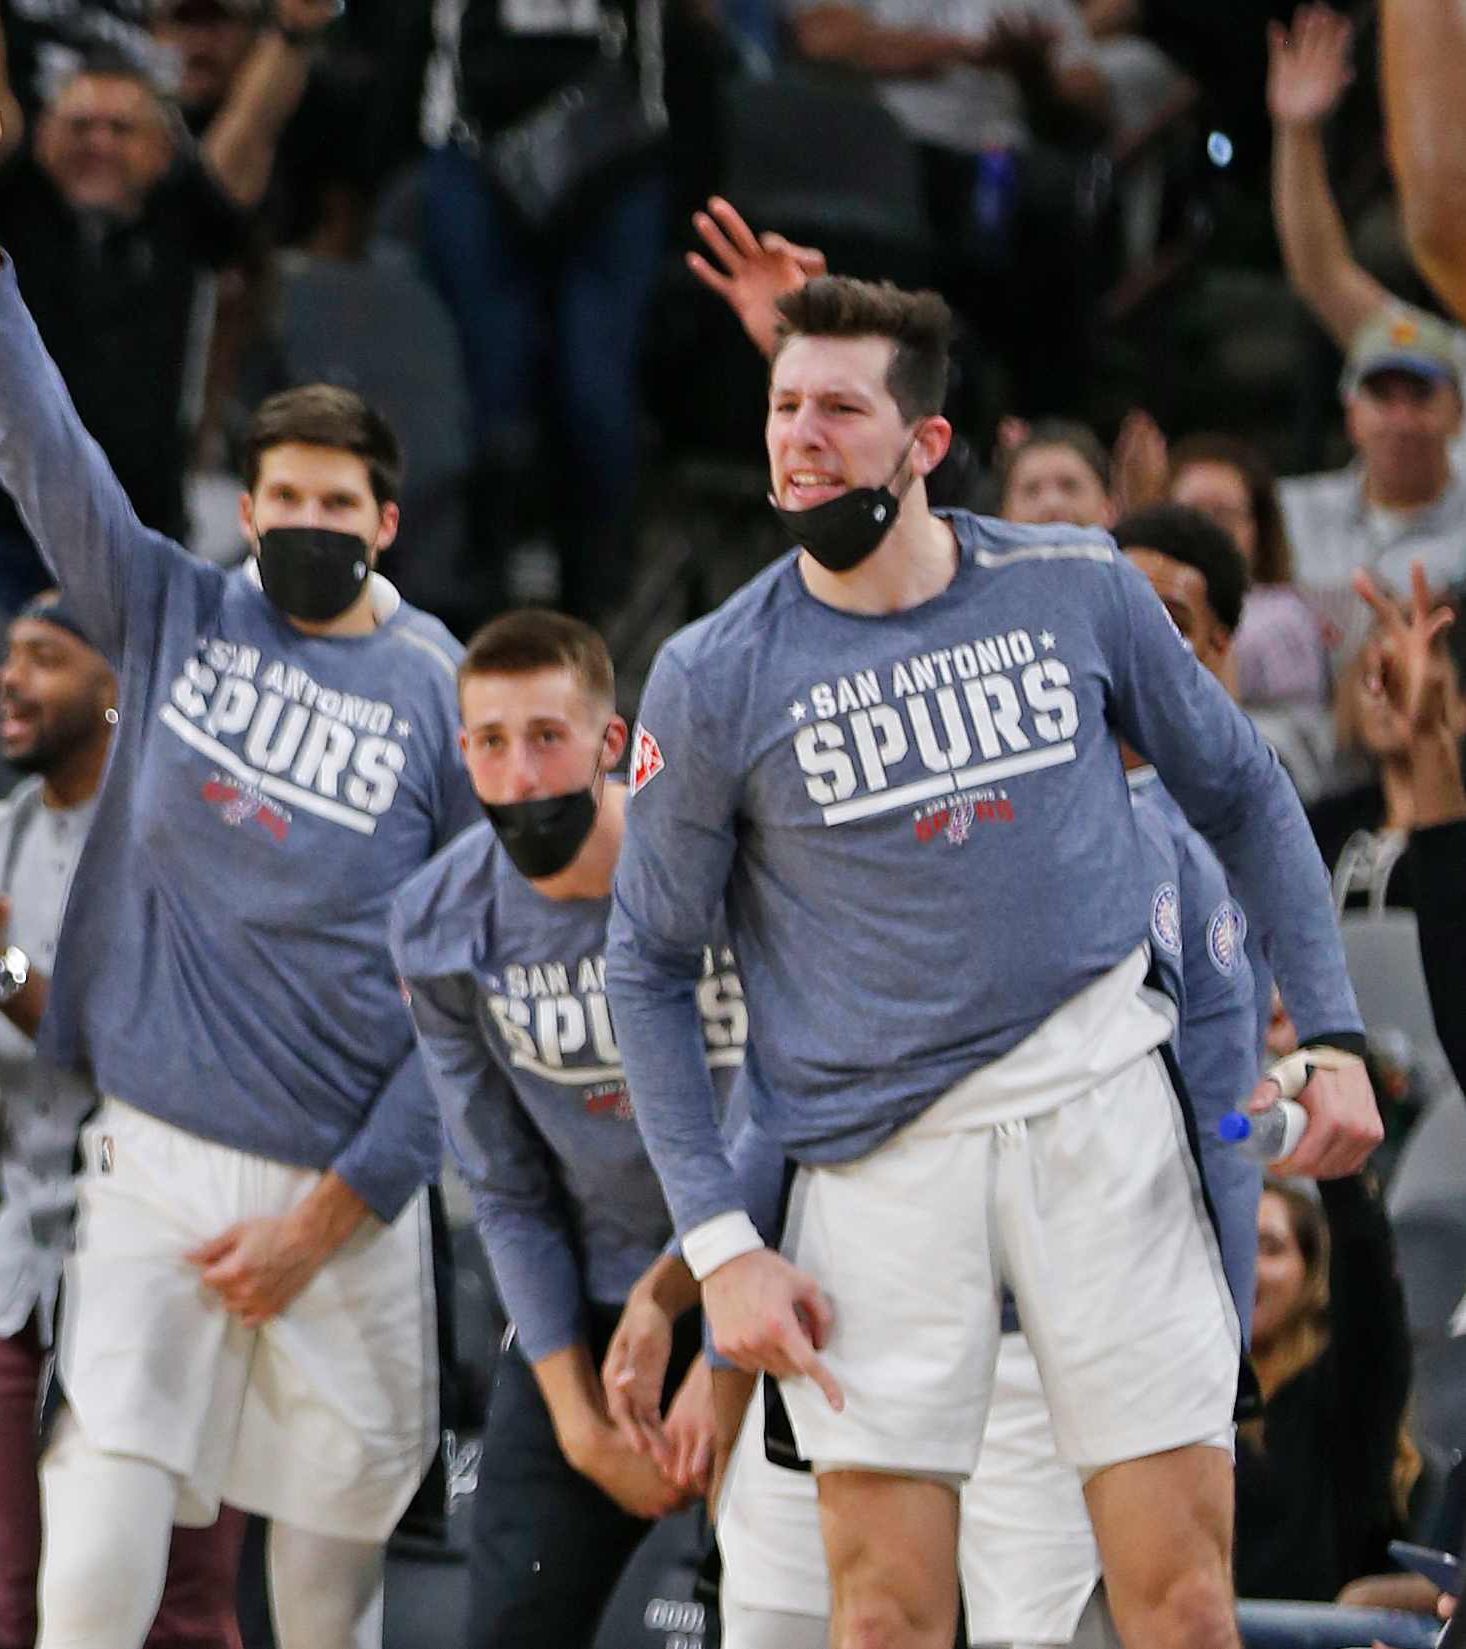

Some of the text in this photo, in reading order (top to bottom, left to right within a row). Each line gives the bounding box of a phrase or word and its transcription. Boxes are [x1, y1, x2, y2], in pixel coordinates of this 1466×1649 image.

[261, 660, 394, 735] ANTONIO
[810, 628, 1036, 719] SAN ANTONIO
[170, 656, 407, 816] SPURS
[792, 656, 1080, 806] SPURS
[503, 960, 571, 999] SAN
